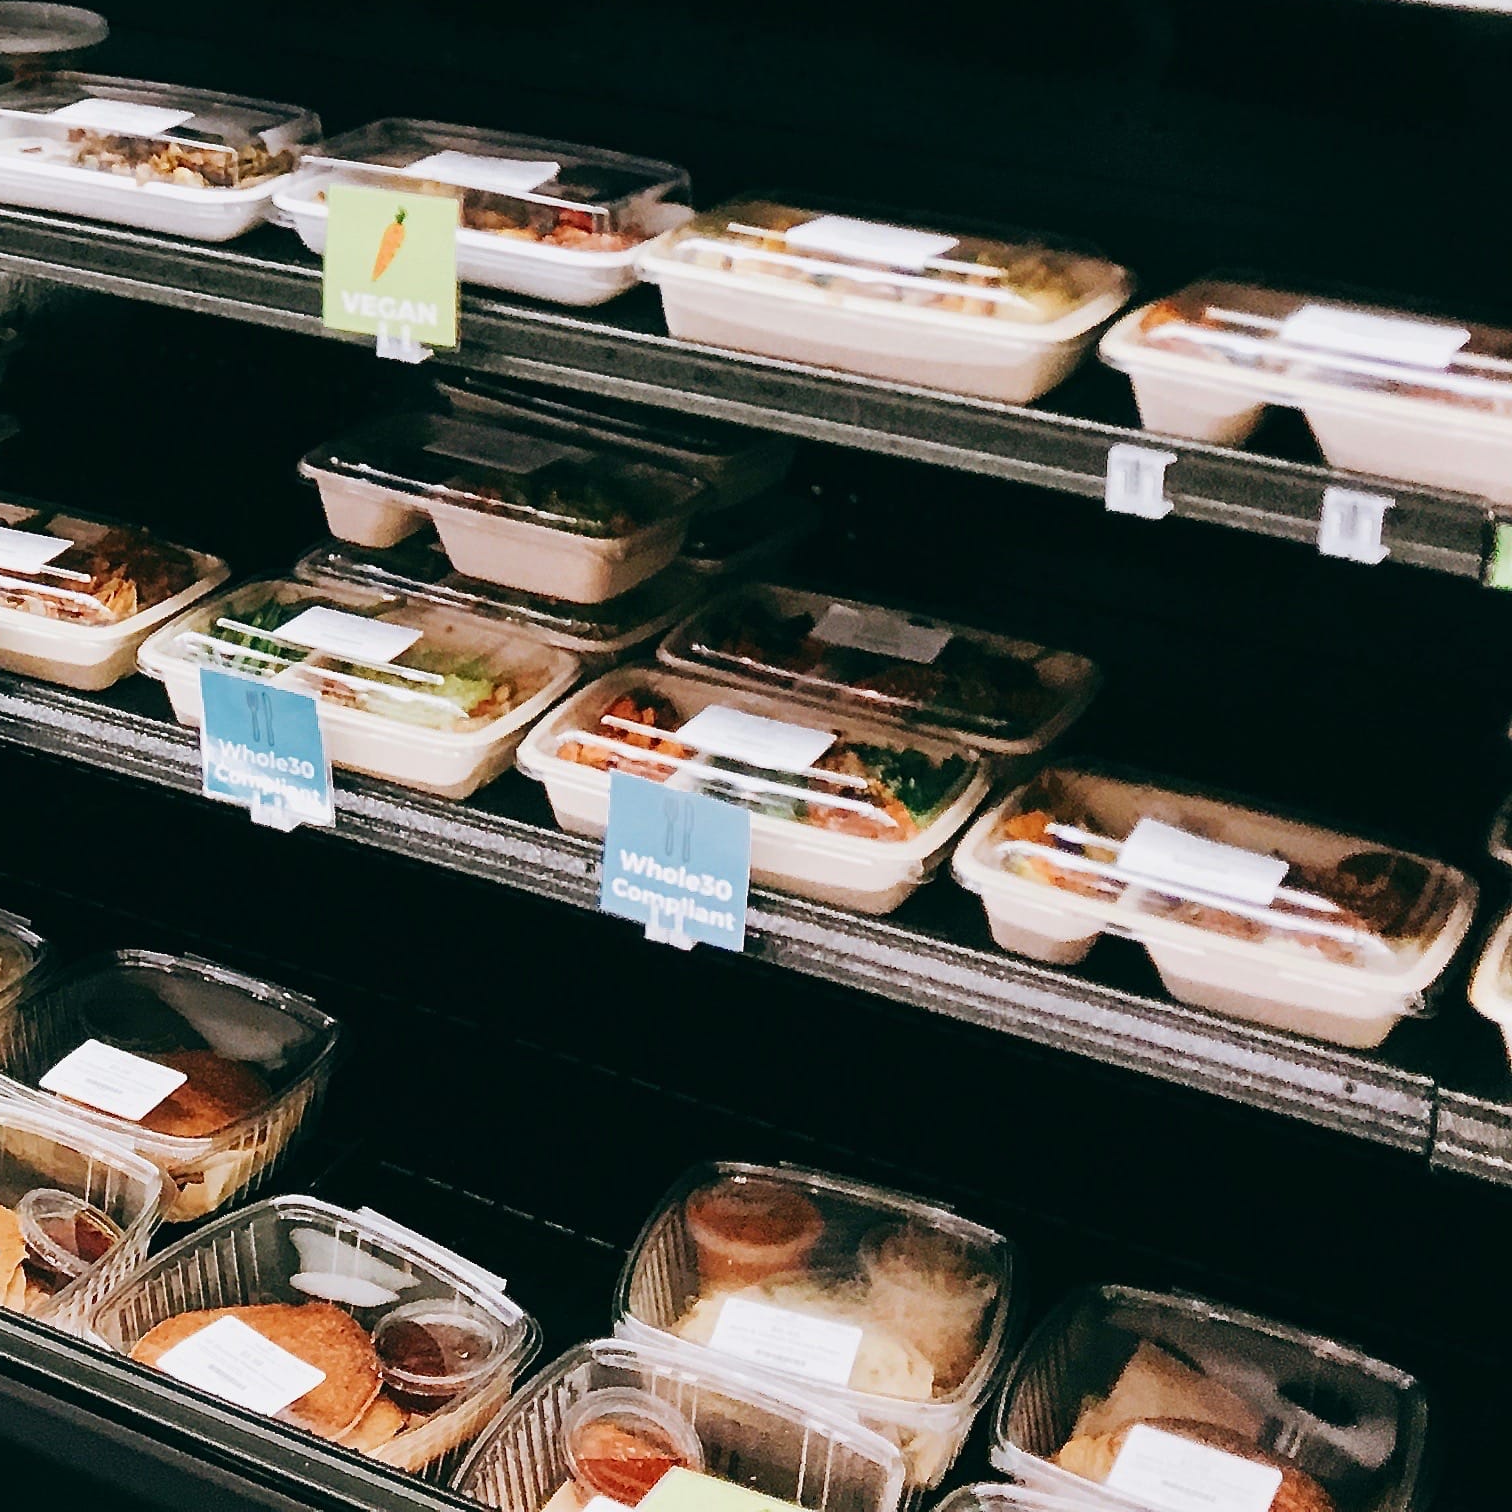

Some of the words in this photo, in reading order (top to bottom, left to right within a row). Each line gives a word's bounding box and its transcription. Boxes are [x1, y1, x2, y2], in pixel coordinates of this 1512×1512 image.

[341, 289, 438, 328] VEGAN
[218, 738, 315, 780] Whole30
[619, 848, 733, 902] Whole30
[611, 877, 737, 932] Compliant
